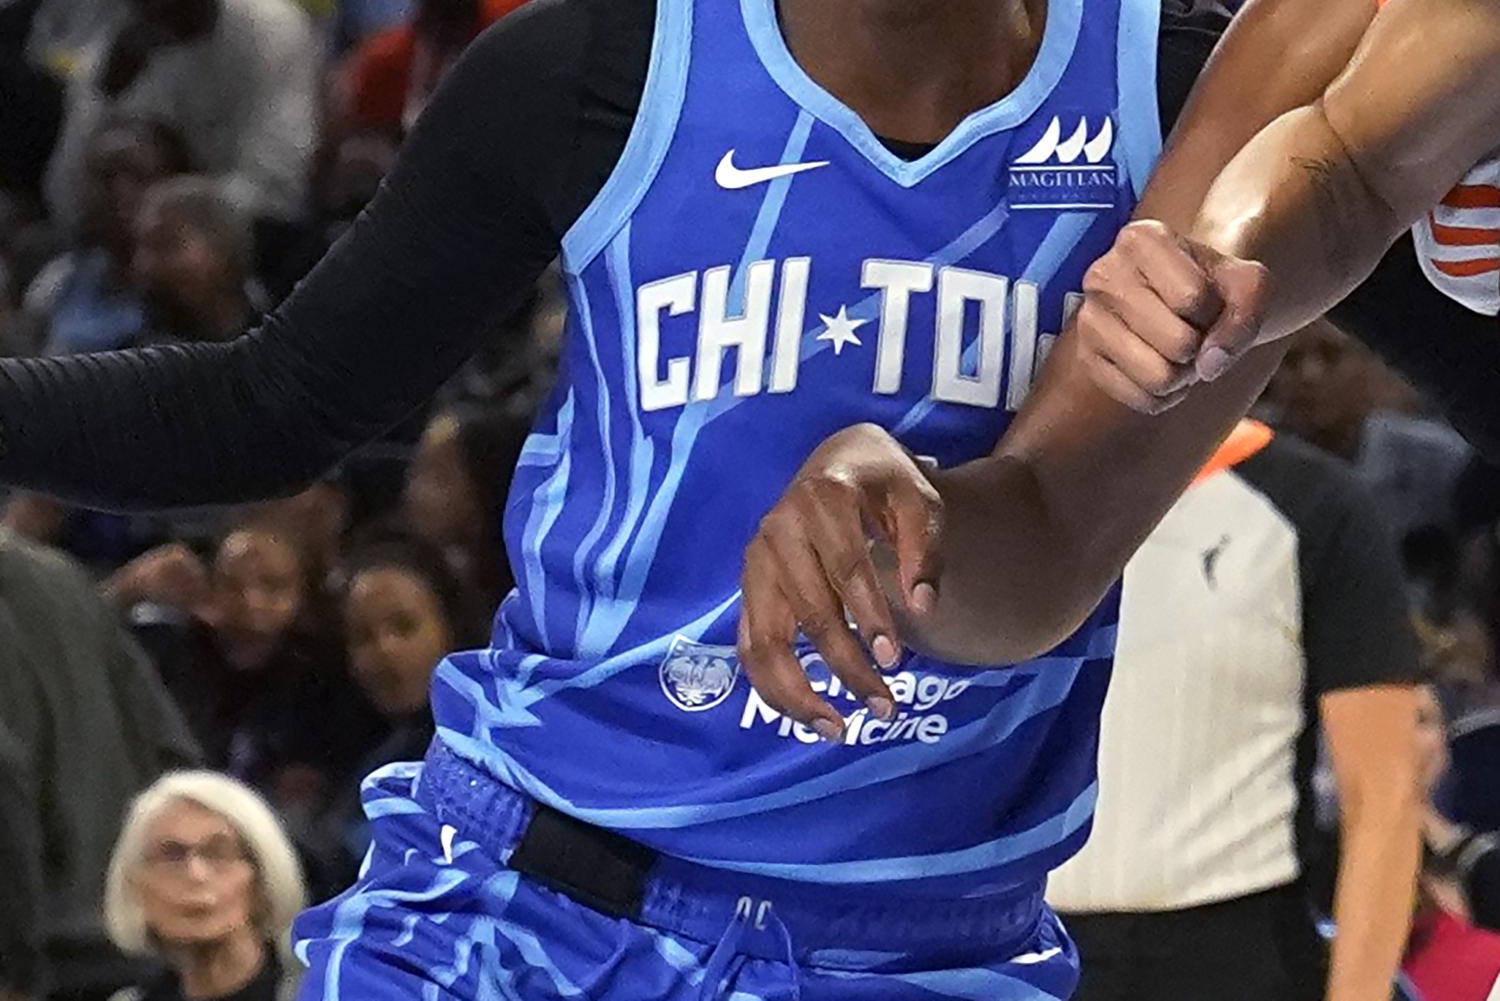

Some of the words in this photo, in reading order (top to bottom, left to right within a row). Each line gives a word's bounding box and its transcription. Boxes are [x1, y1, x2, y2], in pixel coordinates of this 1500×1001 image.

[1009, 172, 1114, 187] MAGELLAN
[637, 256, 810, 411] CHI
[860, 258, 1085, 411] TO
